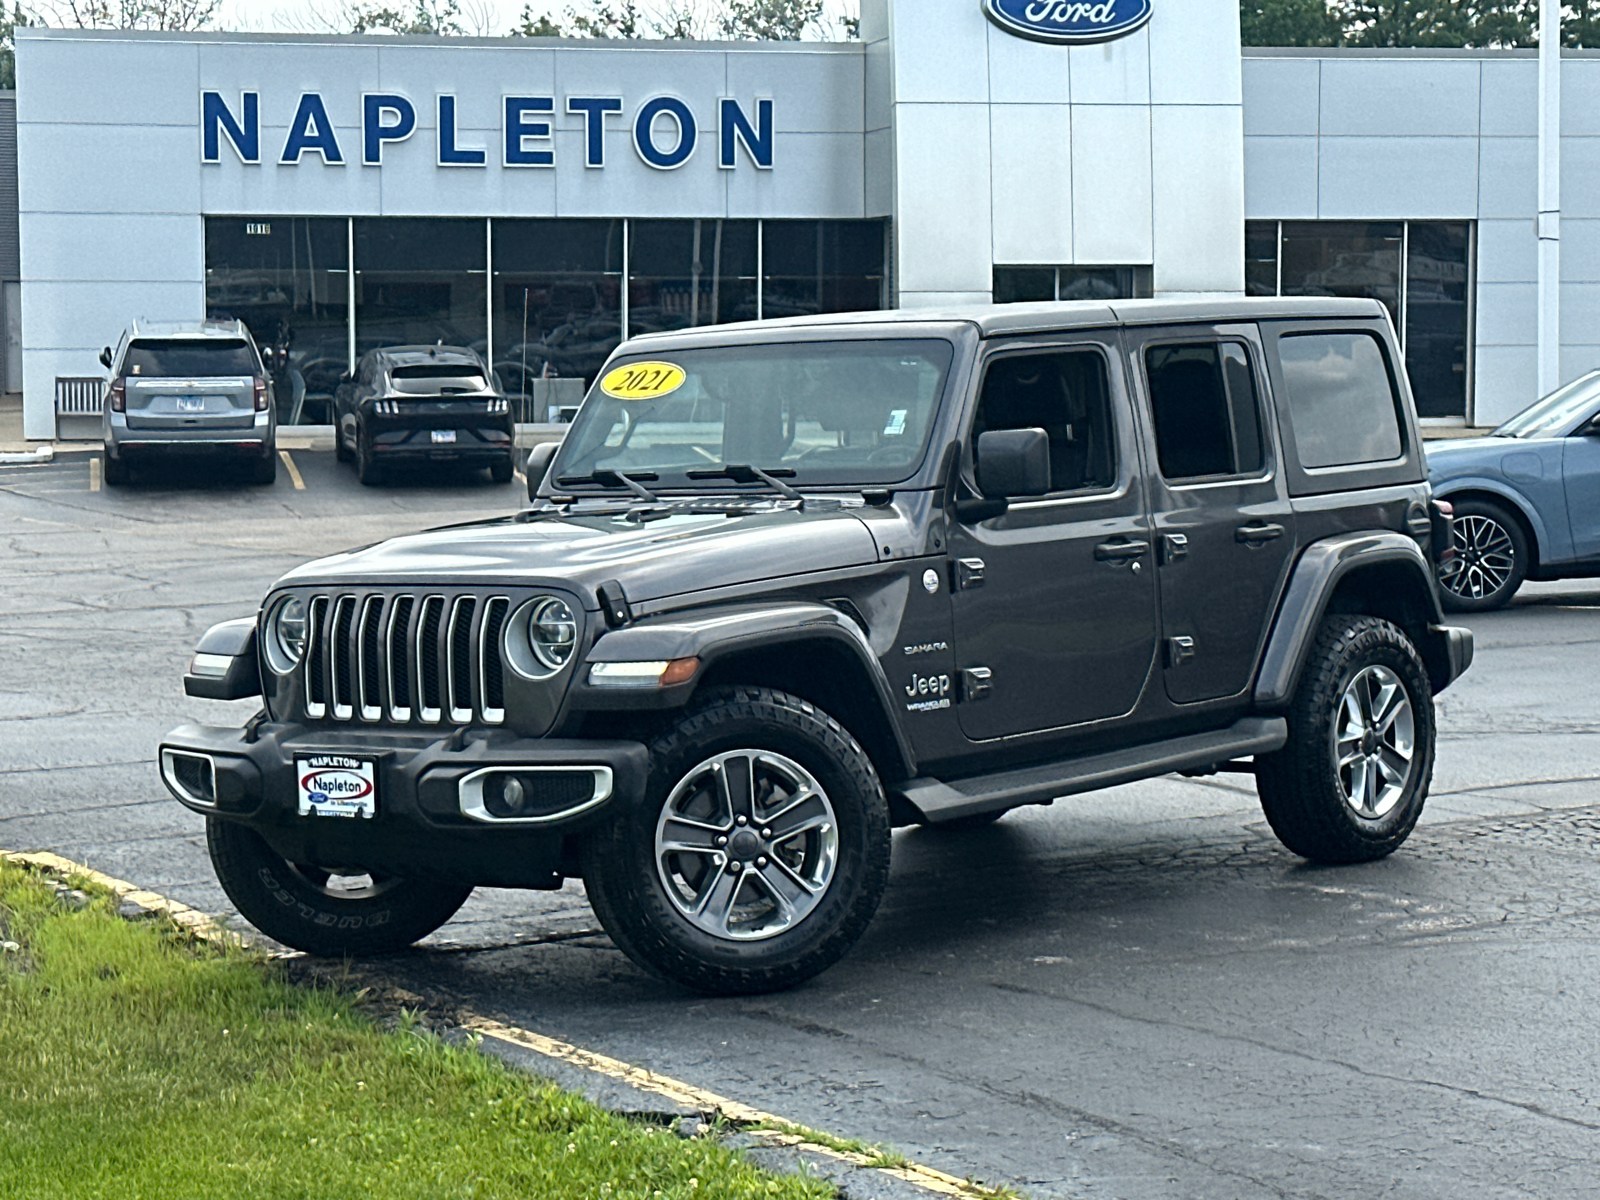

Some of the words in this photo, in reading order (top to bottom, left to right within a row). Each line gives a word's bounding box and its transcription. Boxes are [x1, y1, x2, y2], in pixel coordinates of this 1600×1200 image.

[1025, 0, 1116, 23] Ford
[200, 90, 774, 170] NAPLETON
[611, 370, 674, 391] 2021
[904, 642, 948, 654] SAHARA
[905, 673, 950, 697] Jeep
[310, 756, 359, 768] NAPLETON
[313, 777, 361, 794] Napleton
